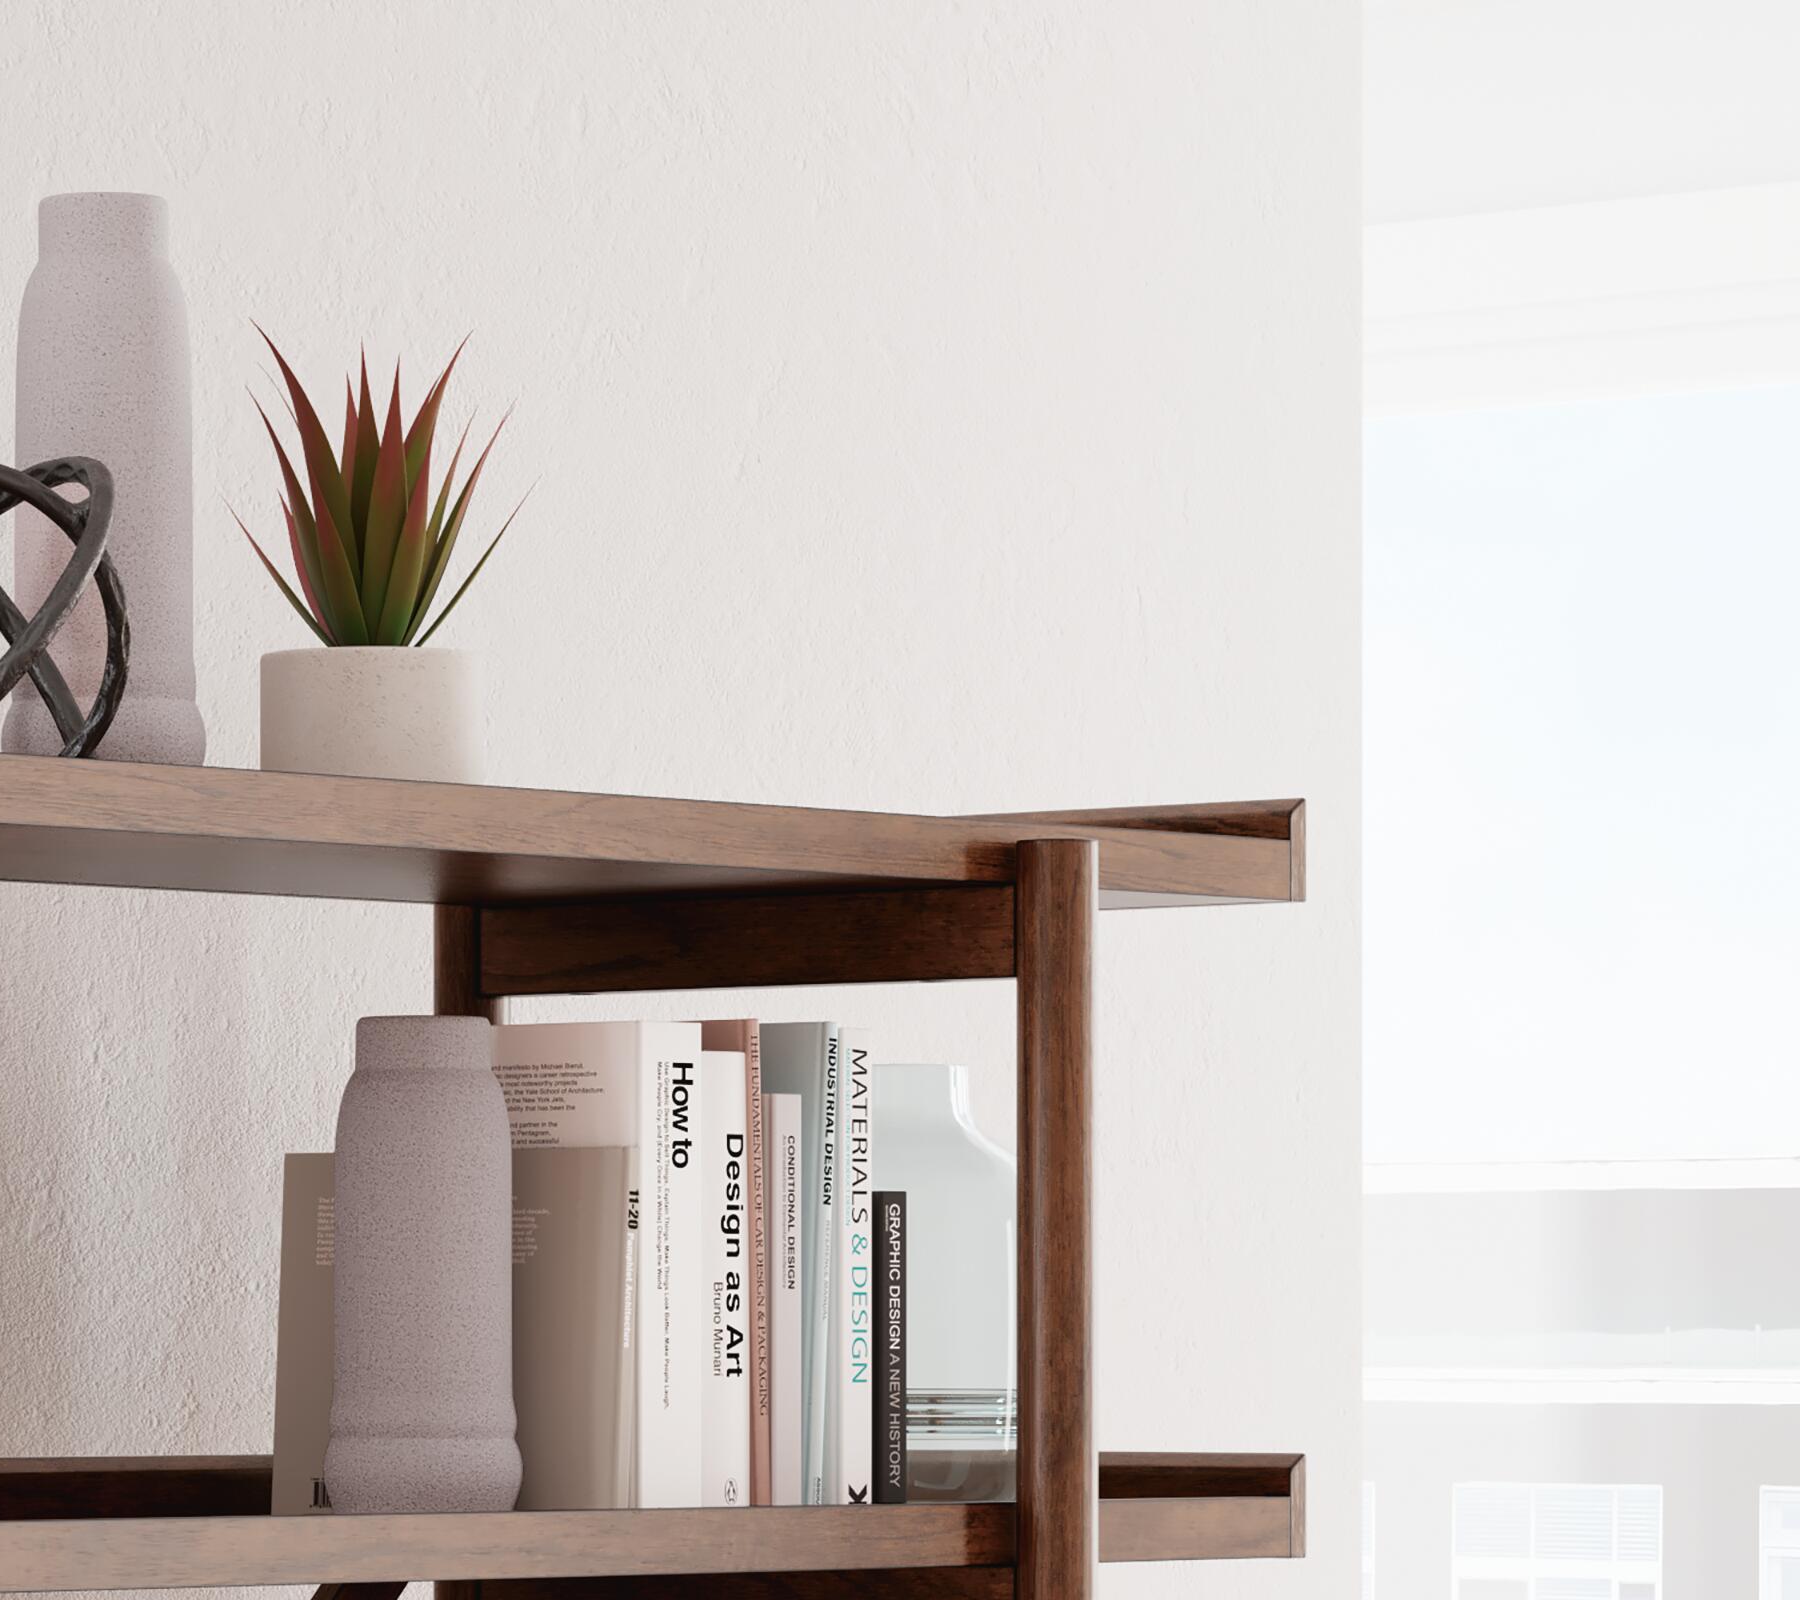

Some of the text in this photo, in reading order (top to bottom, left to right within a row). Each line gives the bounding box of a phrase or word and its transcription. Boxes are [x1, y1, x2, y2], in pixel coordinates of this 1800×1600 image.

[672, 1062, 694, 1168] How to
[823, 1037, 837, 1206] INDUSTRIAL DESIGN
[623, 1232, 634, 1348] Pamphlet Architecture
[628, 1189, 640, 1229] 11-20
[721, 1134, 744, 1377] Design as Art
[750, 1034, 768, 1416] THE FUNDAMENTALS OF CAR DESIGN & PACKAGING
[851, 1049, 868, 1384] MATERIALS & DESIGN
[713, 1282, 723, 1376] Bruno Munari
[889, 1203, 900, 1488] GRAPHIC DESIGN A NEW HISTORY
